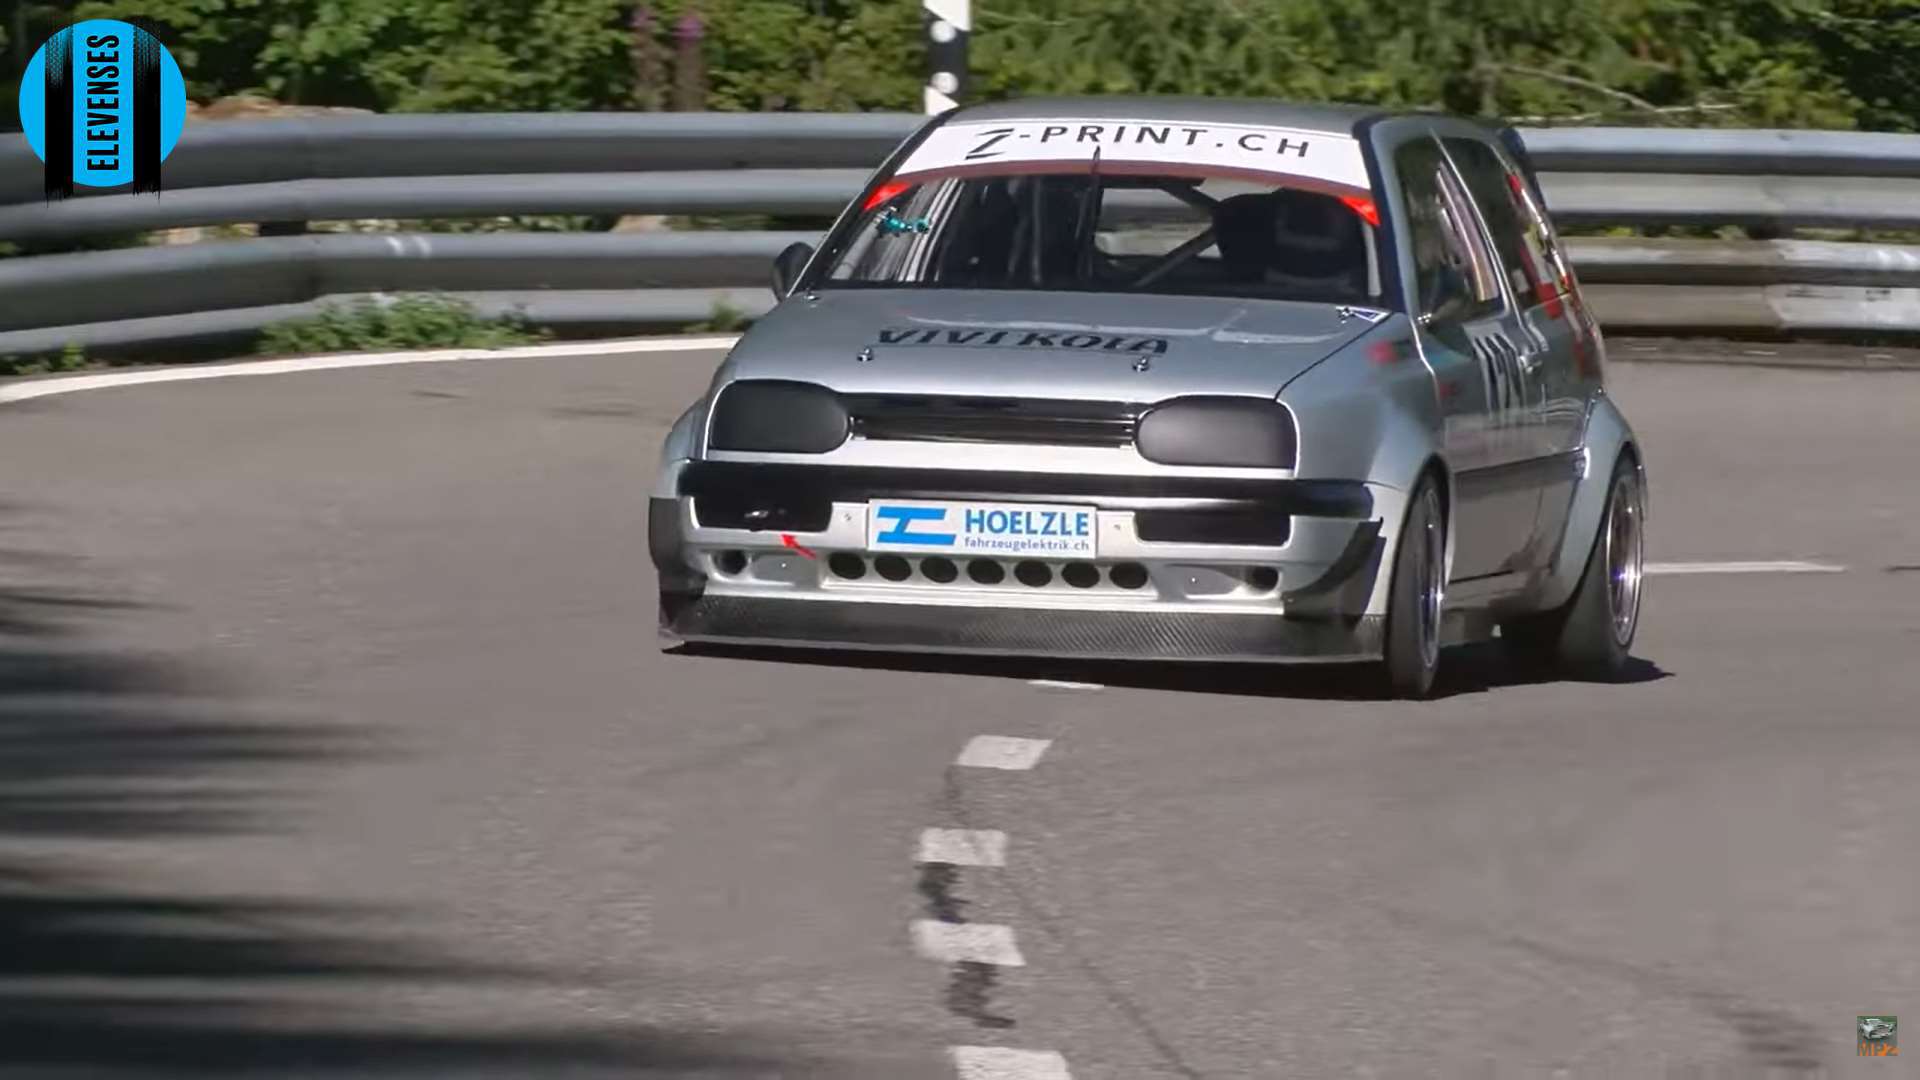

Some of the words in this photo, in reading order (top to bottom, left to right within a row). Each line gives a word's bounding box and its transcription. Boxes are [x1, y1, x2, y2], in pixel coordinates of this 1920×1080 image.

[964, 125, 1309, 160] Z-PRINT.CH
[965, 509, 1090, 536] HOELZLE
[964, 536, 1089, 551] fahrzeugelektrik.ch
